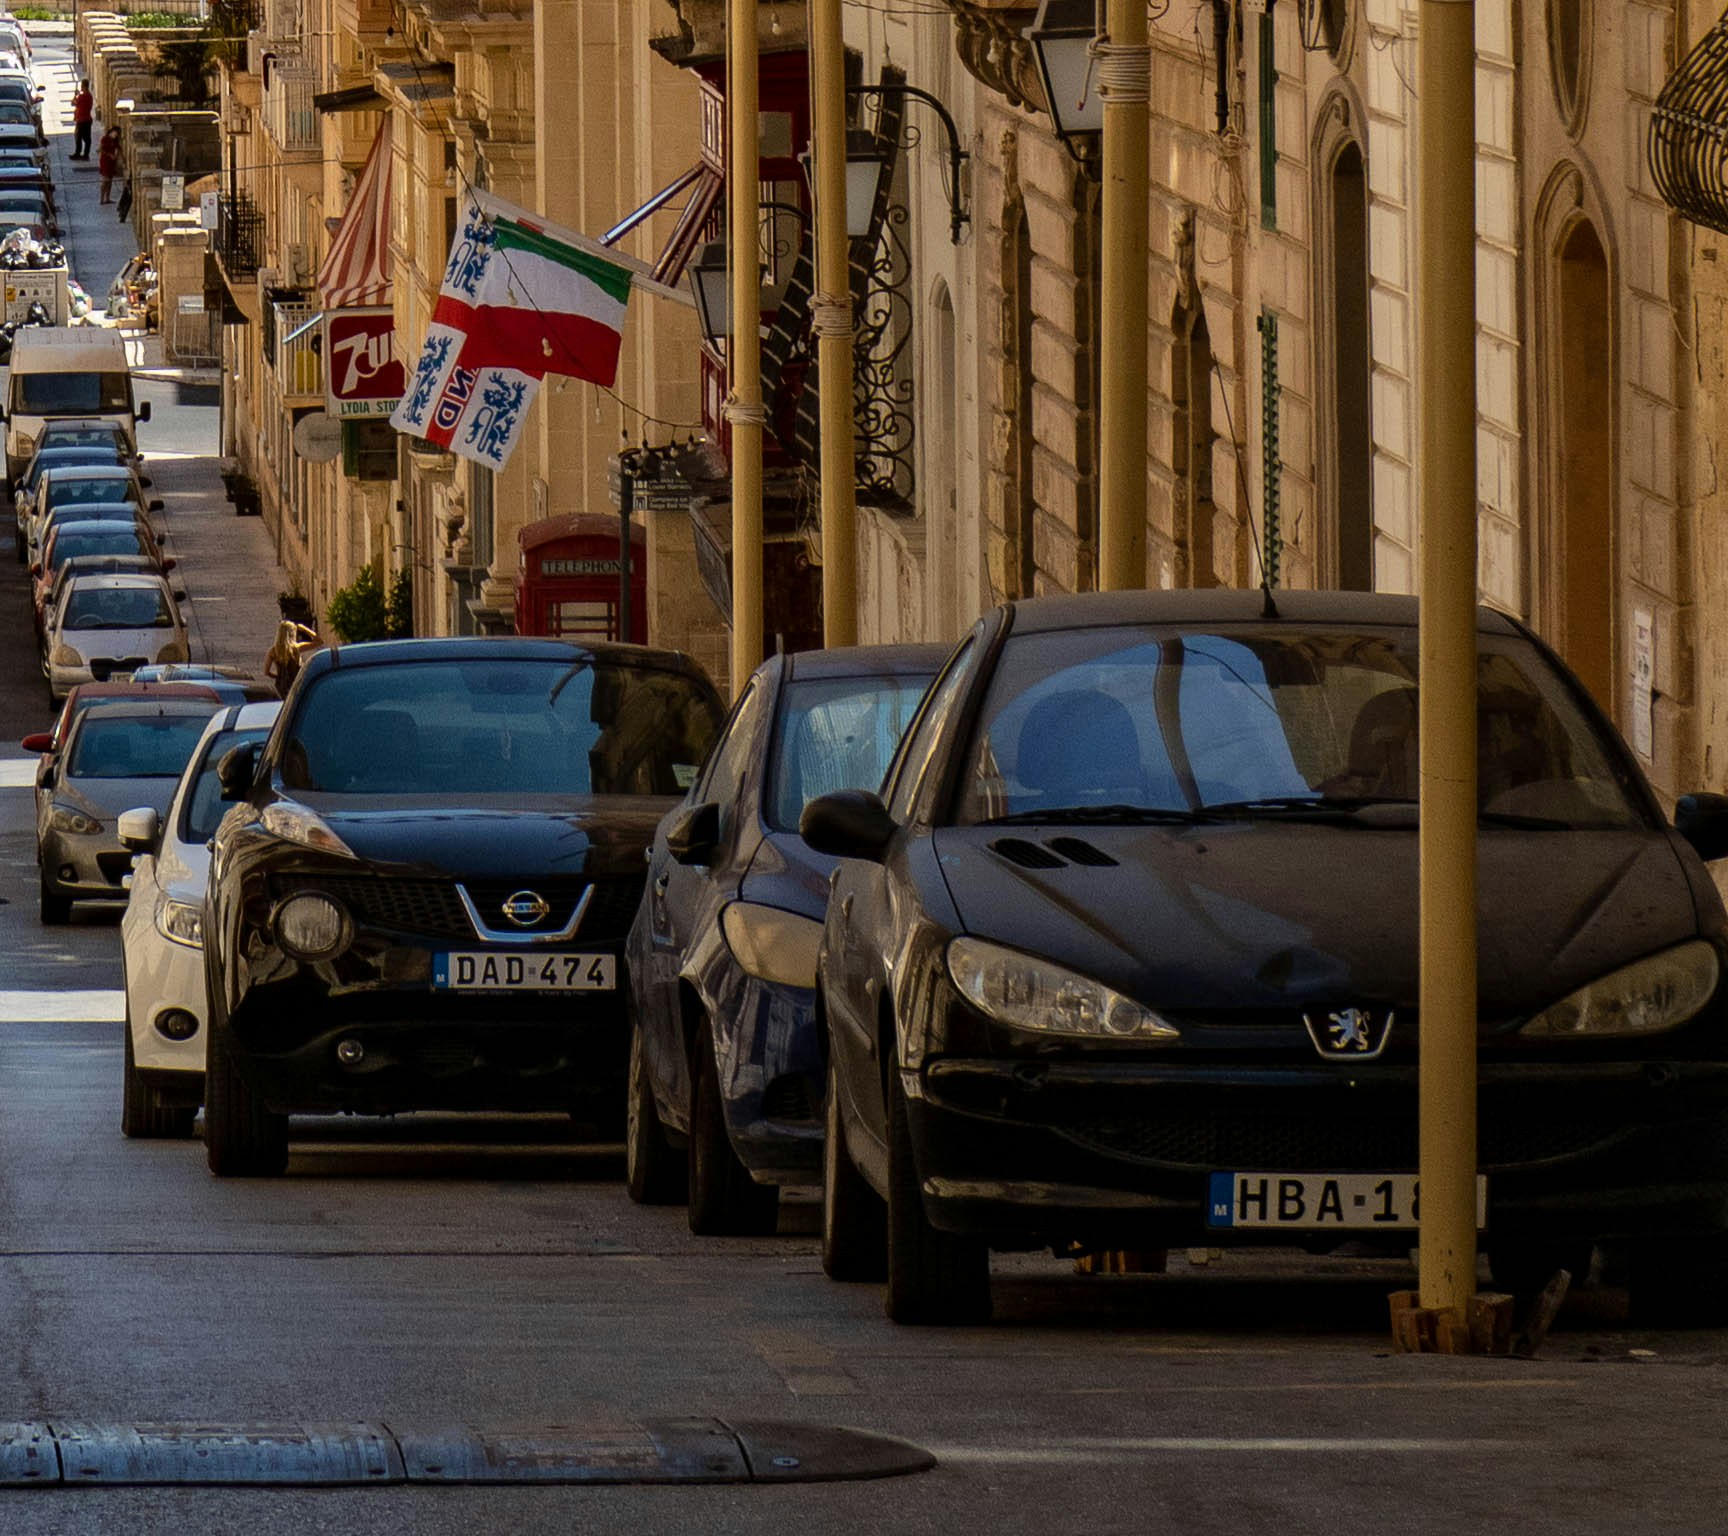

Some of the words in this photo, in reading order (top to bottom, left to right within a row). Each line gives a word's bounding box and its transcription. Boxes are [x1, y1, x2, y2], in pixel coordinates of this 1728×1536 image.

[341, 401, 370, 415] LYDIA
[544, 560, 624, 574] TELEPHON
[456, 956, 525, 985] DAD
[540, 957, 605, 986] 474
[1238, 1178, 1344, 1222] HBA
